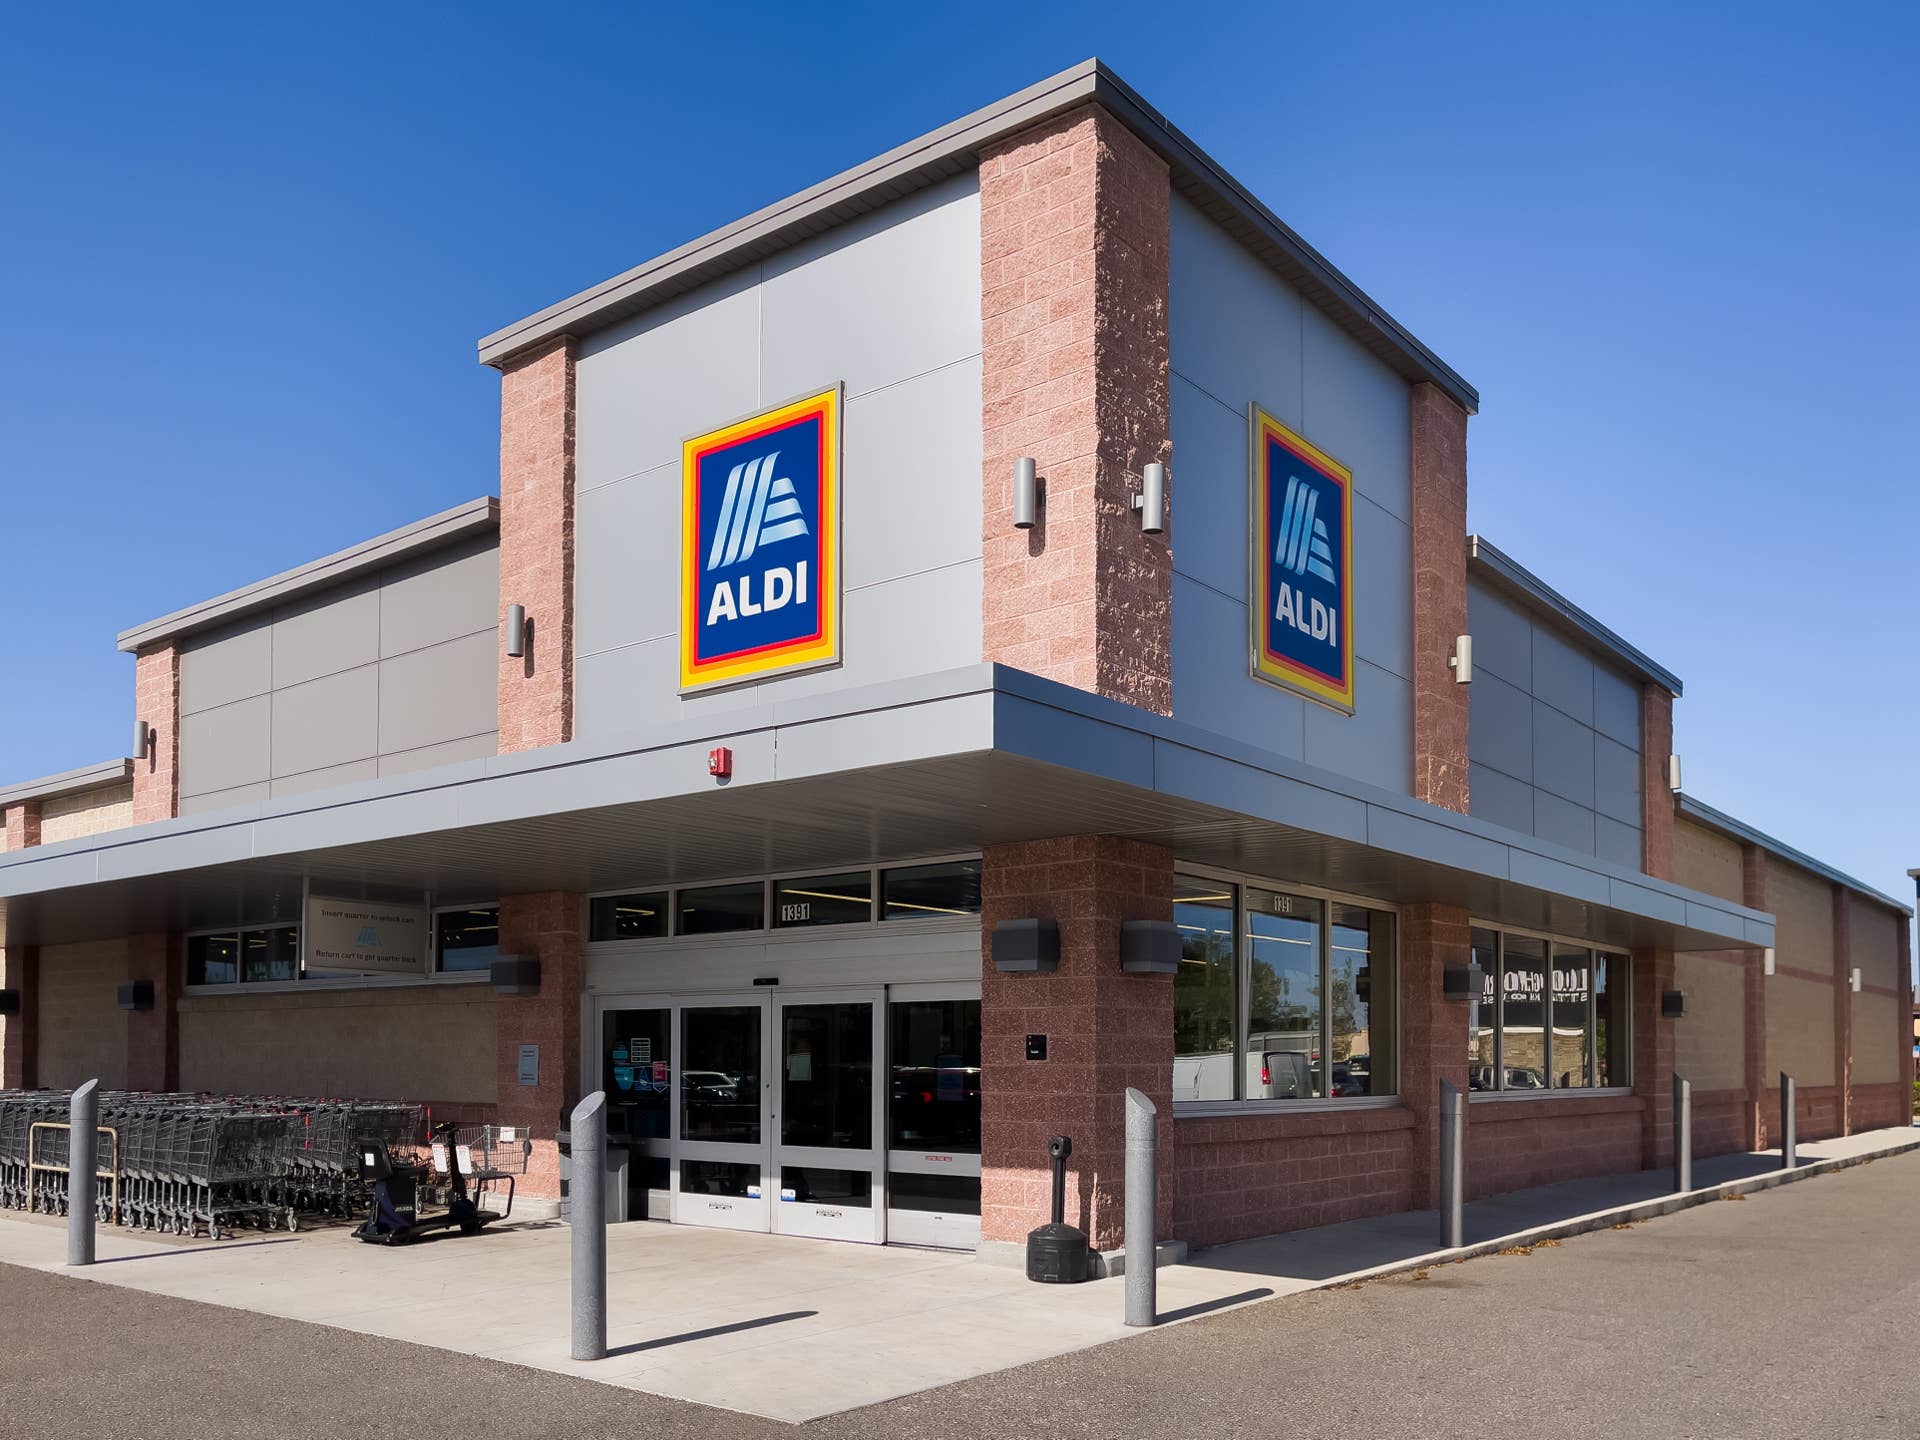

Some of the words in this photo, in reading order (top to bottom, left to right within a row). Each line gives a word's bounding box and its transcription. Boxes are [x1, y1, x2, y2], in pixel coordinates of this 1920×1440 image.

[706, 560, 808, 626] ALDI
[1275, 581, 1337, 648] ALDI
[783, 903, 809, 920] 1391
[1274, 895, 1292, 913] 1391
[321, 909, 342, 918] Insert
[344, 911, 369, 921] quarter
[379, 914, 400, 922] unlock
[401, 916, 415, 924] cart
[315, 949, 340, 959] Return
[341, 951, 355, 959] cart
[356, 952, 363, 960] to
[364, 953, 376, 962] get
[377, 954, 401, 963] quarter
[402, 955, 416, 963] back
